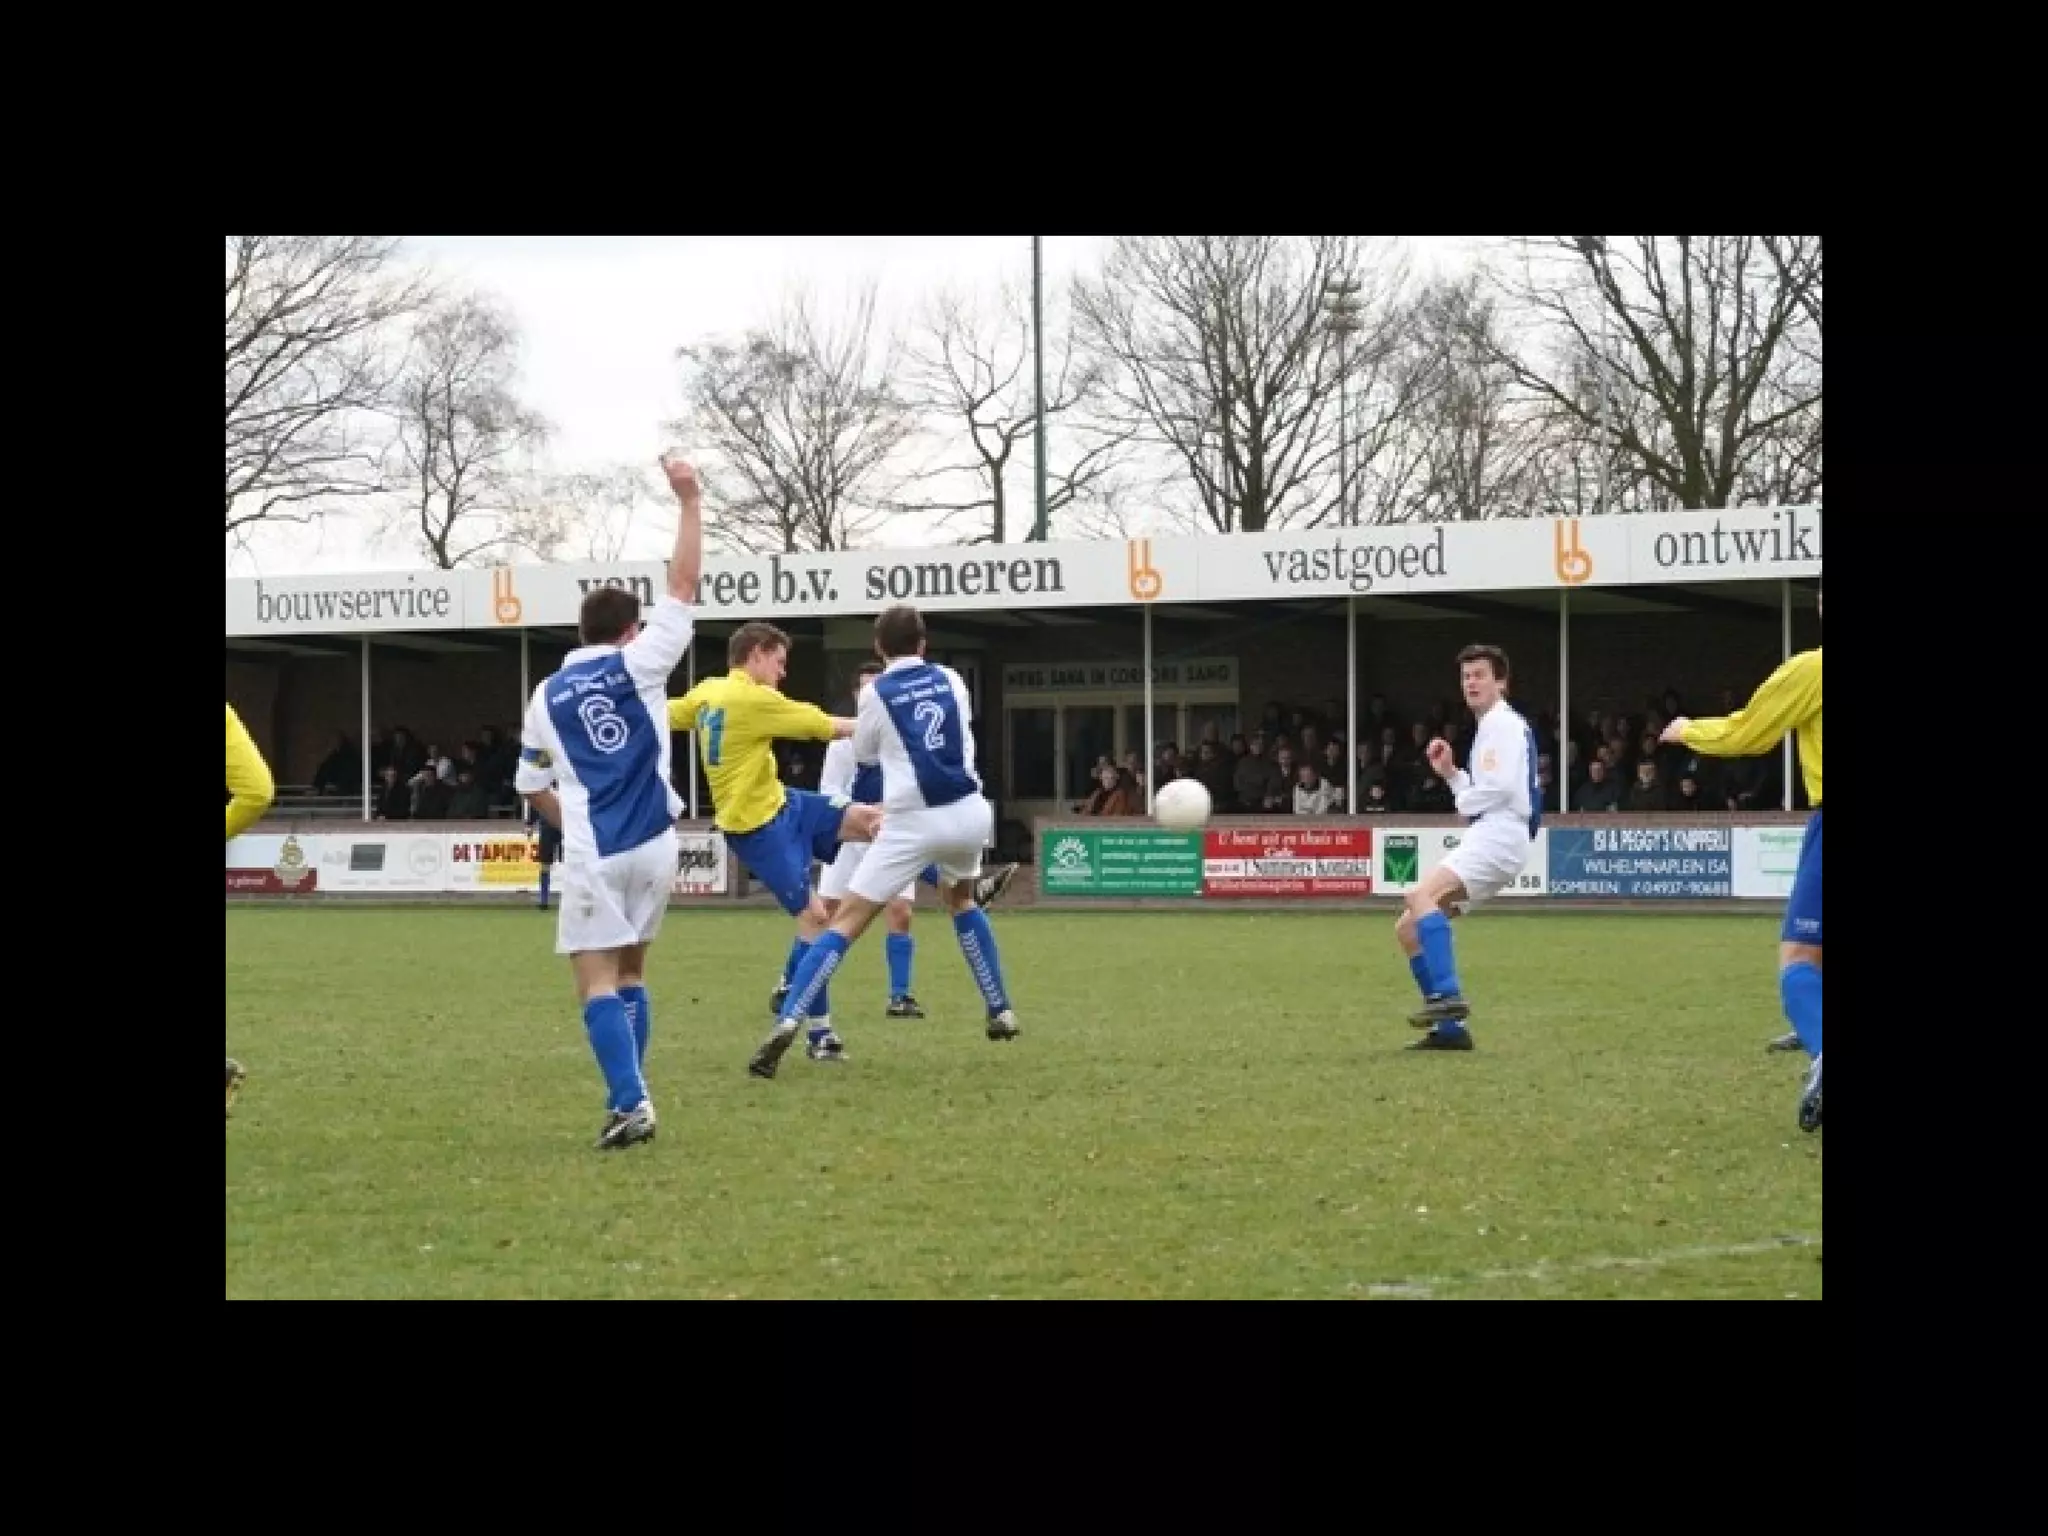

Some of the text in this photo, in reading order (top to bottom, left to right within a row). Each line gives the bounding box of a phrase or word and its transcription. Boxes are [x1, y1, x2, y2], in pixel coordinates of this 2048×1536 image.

[664, 559, 762, 606] ree
[769, 554, 838, 604] b.v.
[866, 556, 1066, 600] someren
[1262, 526, 1447, 591] vastgoed
[254, 574, 450, 623] bouwservice
[578, 693, 629, 754] 6
[914, 700, 945, 751] 2
